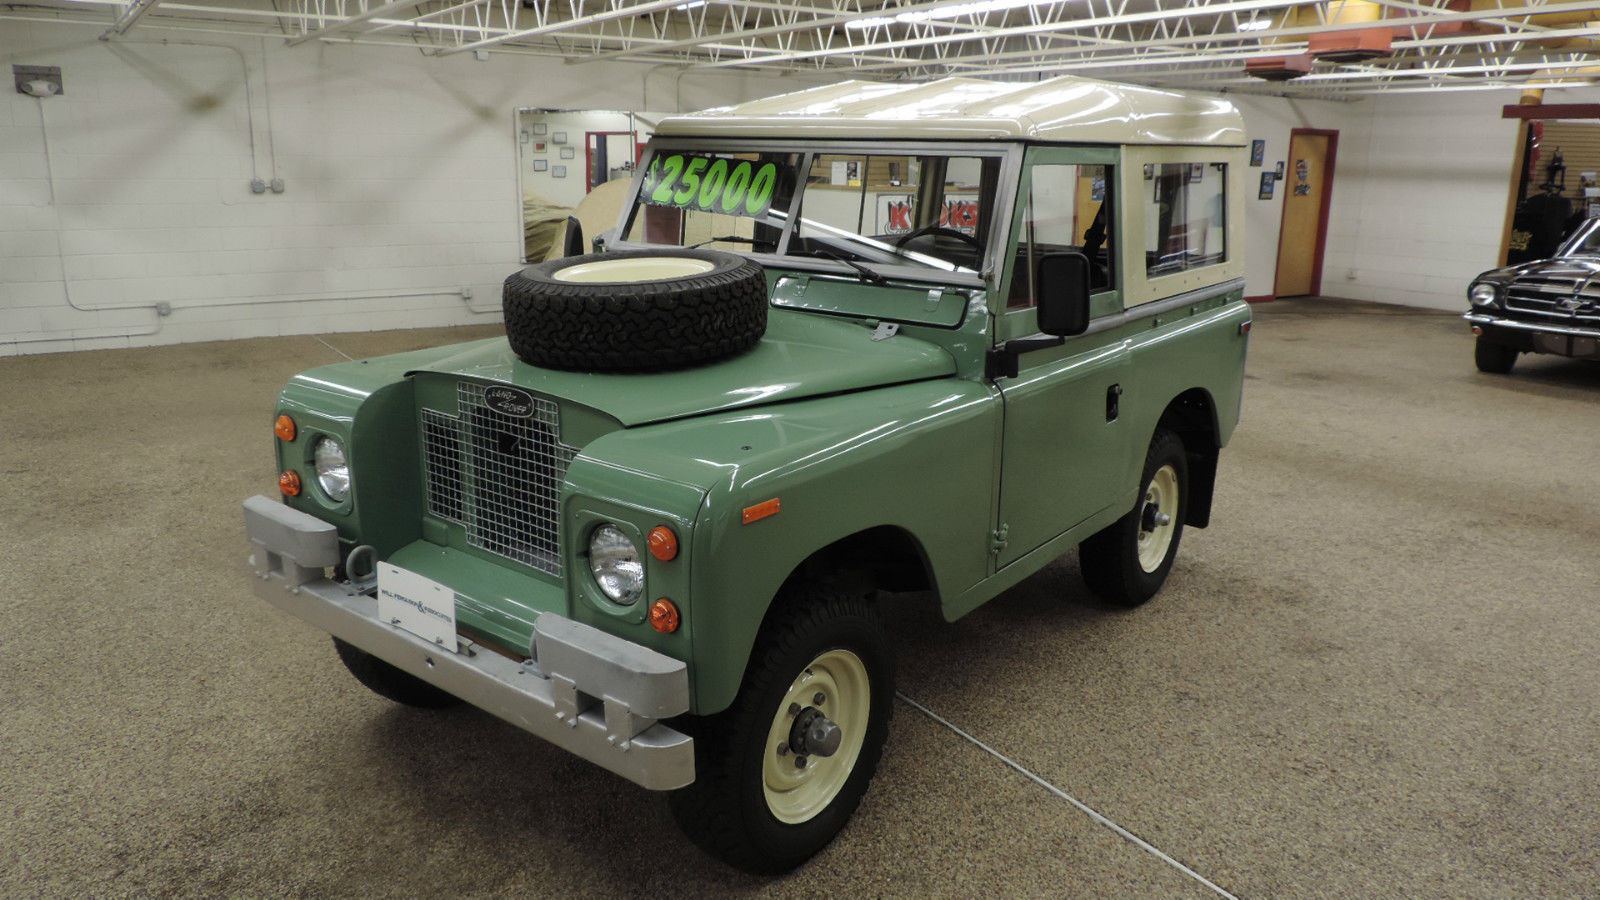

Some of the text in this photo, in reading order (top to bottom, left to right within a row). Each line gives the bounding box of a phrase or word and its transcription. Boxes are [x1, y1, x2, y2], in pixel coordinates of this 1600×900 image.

[888, 200, 979, 229] KKS
[491, 389, 512, 400] LAND
[503, 402, 527, 414] ROVER
[381, 589, 394, 598] WILL
